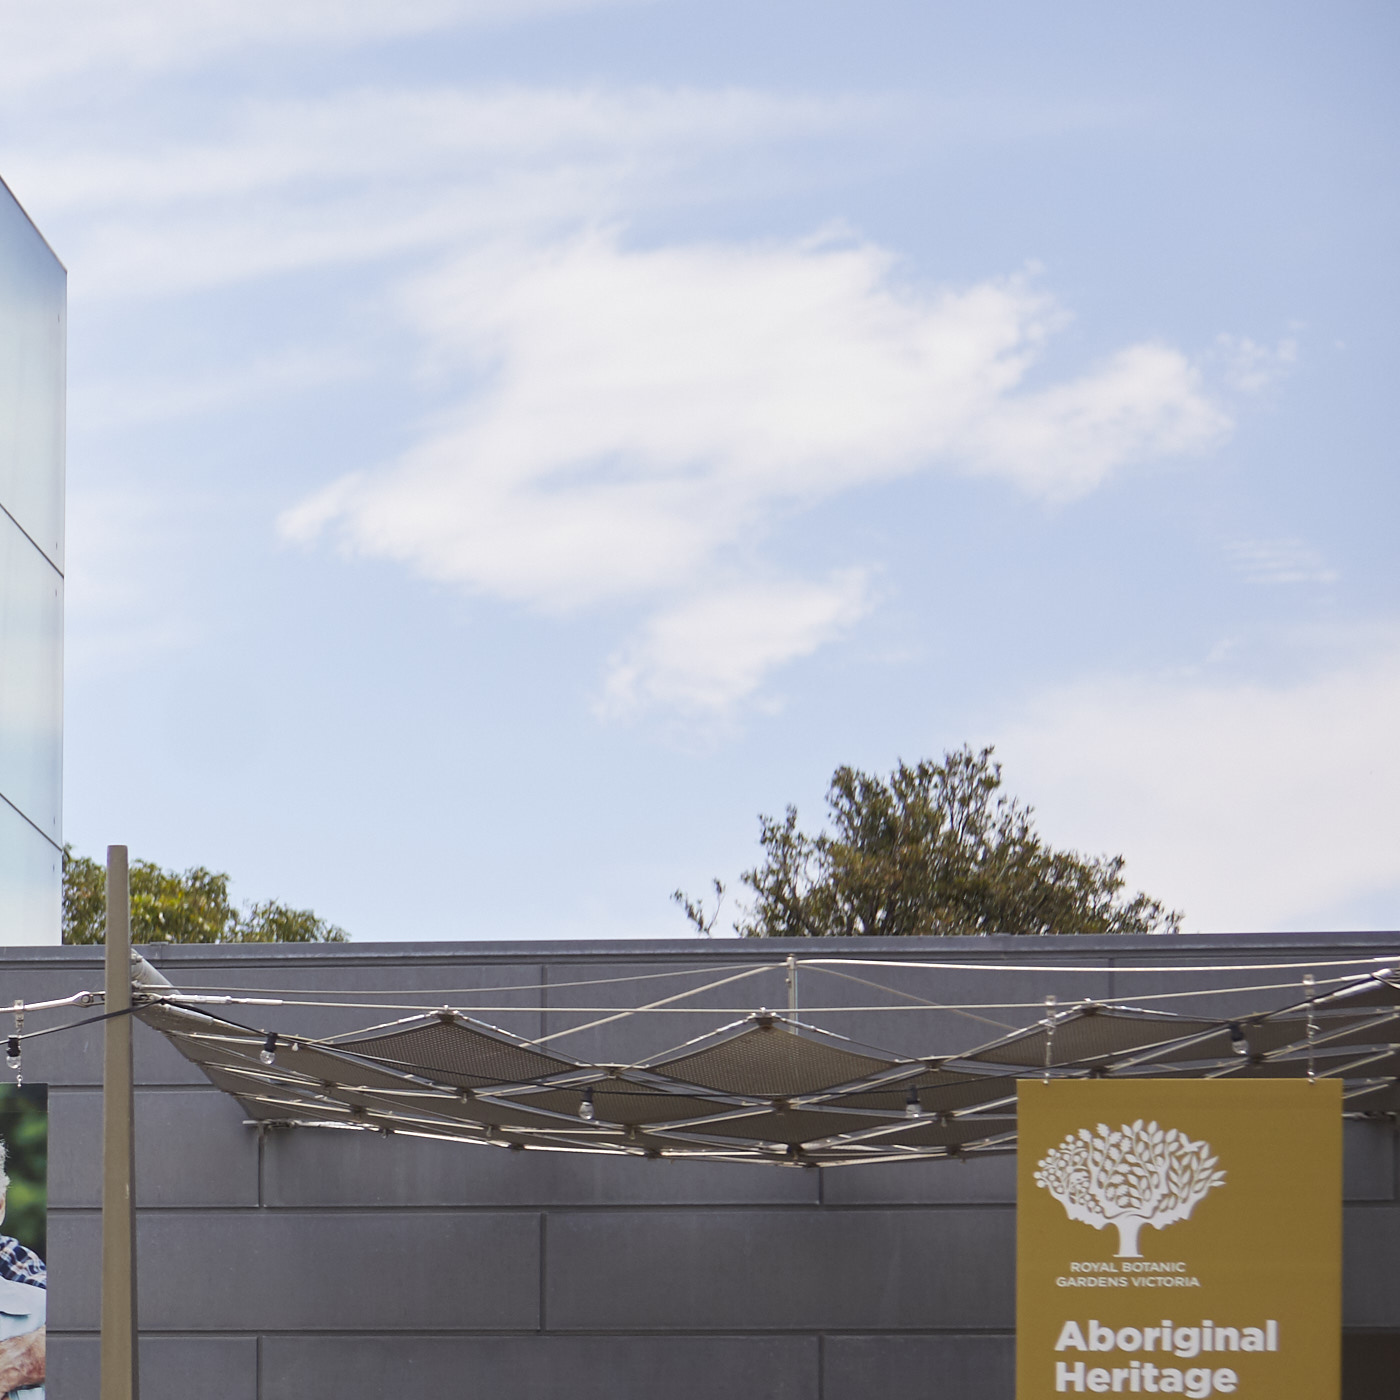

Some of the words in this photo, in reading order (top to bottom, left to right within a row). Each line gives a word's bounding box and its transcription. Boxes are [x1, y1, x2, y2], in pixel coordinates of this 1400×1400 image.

[1070, 1261, 1119, 1273] ROYAL
[1122, 1261, 1186, 1273] BOTANIC
[1056, 1276, 1129, 1287] GARDENS
[1131, 1276, 1200, 1287] VICTORIA
[1055, 1319, 1277, 1358] Aboriginal
[1055, 1360, 1238, 1399] Heritage
